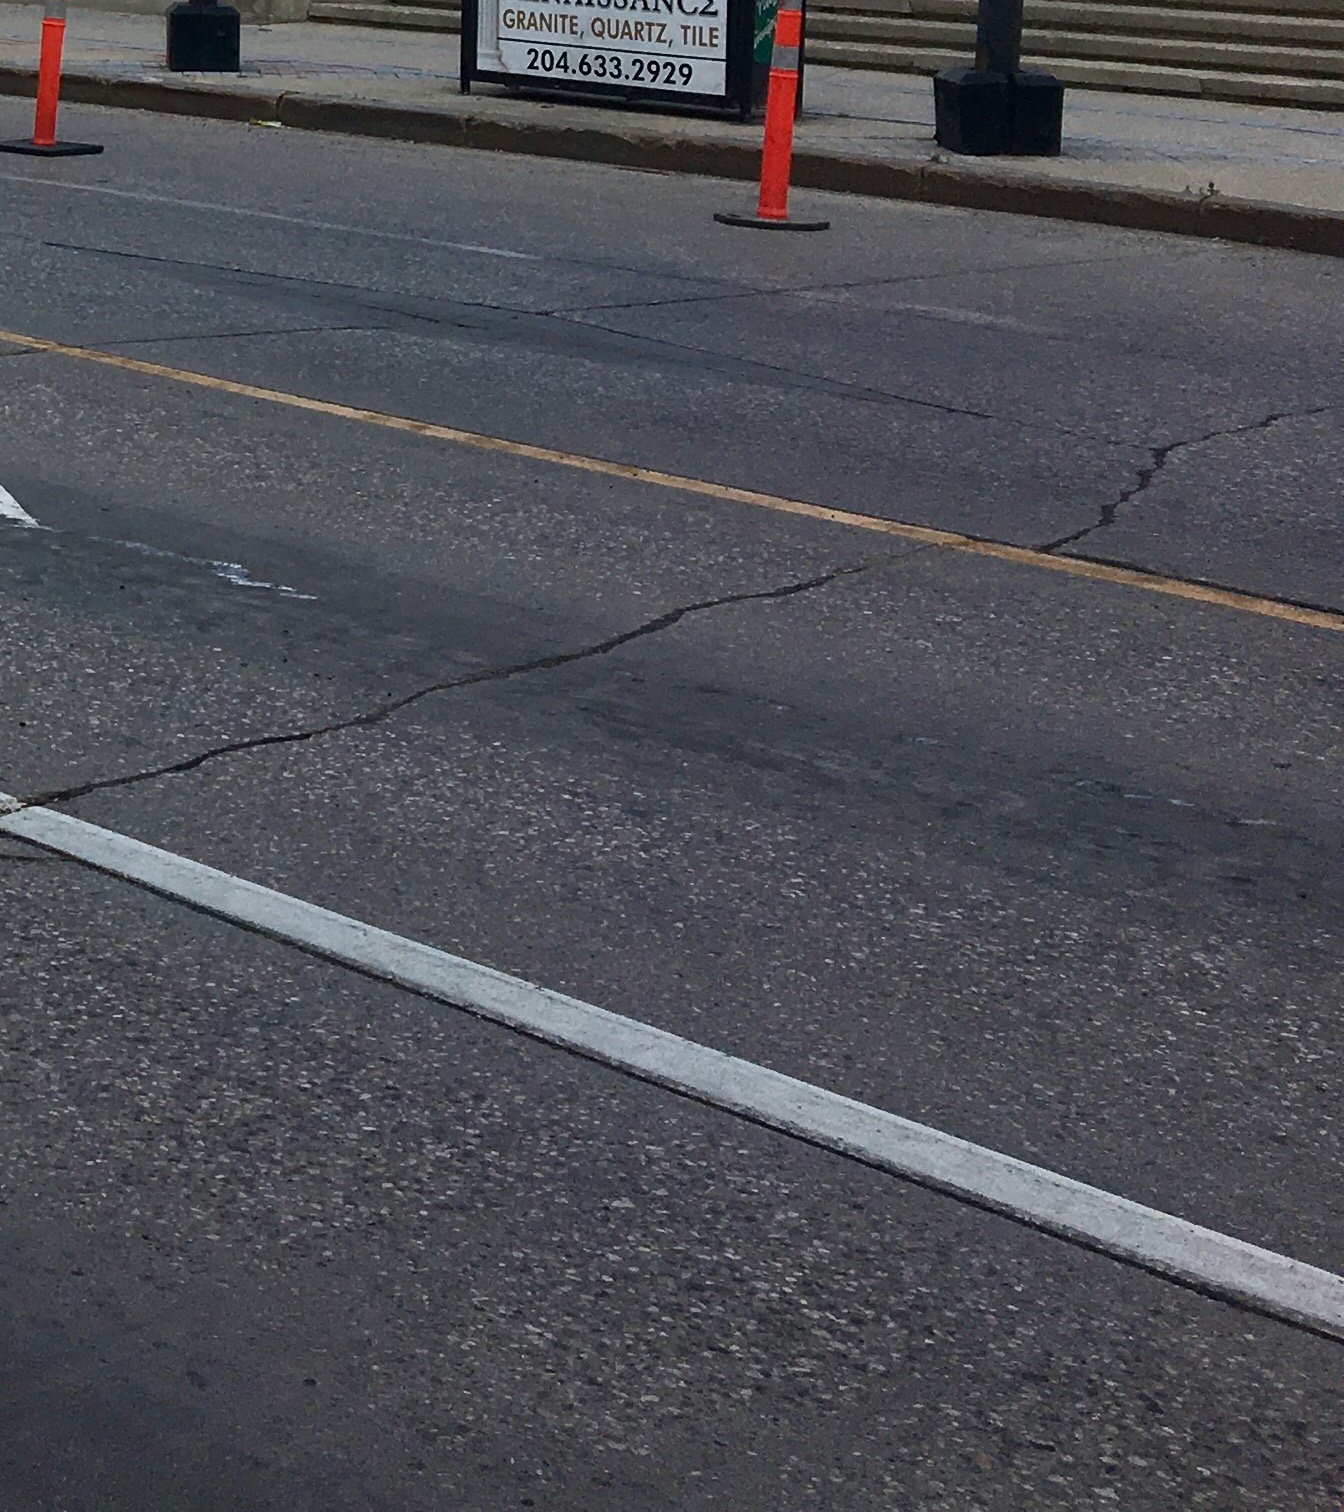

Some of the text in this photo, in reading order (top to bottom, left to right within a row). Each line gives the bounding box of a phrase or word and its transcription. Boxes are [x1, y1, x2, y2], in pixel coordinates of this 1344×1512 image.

[502, 8, 584, 39] GRANITE,
[591, 16, 674, 48] QUARTZ,
[680, 24, 719, 48] TILE
[526, 47, 694, 87] 204.633.2929
